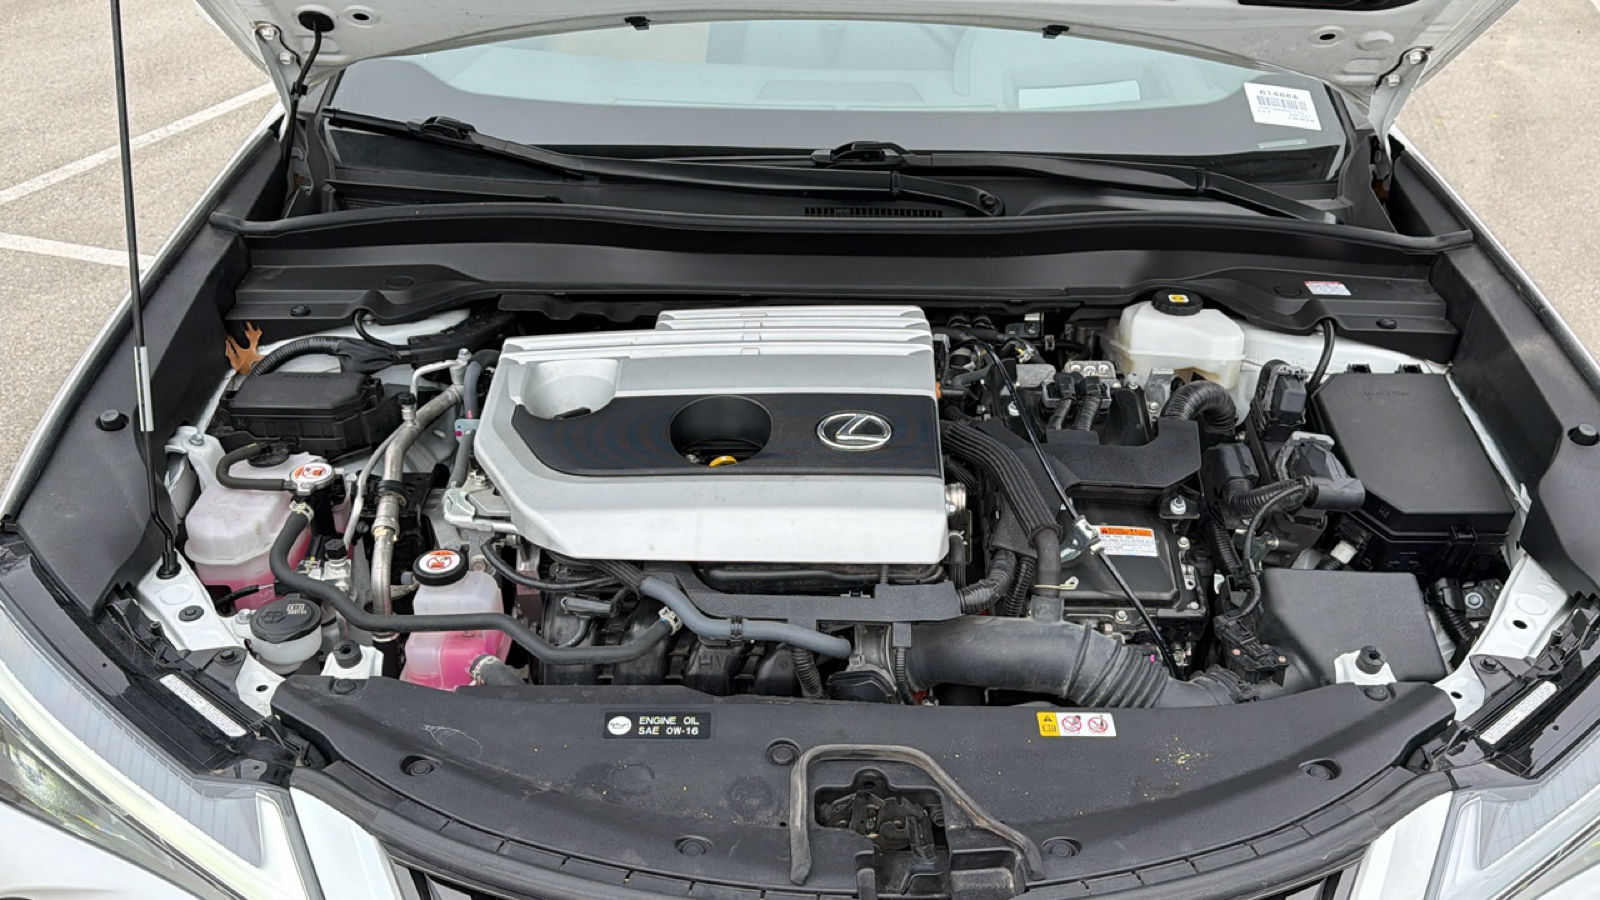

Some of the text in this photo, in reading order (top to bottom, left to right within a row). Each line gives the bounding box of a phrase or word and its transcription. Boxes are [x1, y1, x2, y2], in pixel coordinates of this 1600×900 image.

[639, 716, 700, 725] ENGINE OIL
[638, 726, 660, 735] SAE
